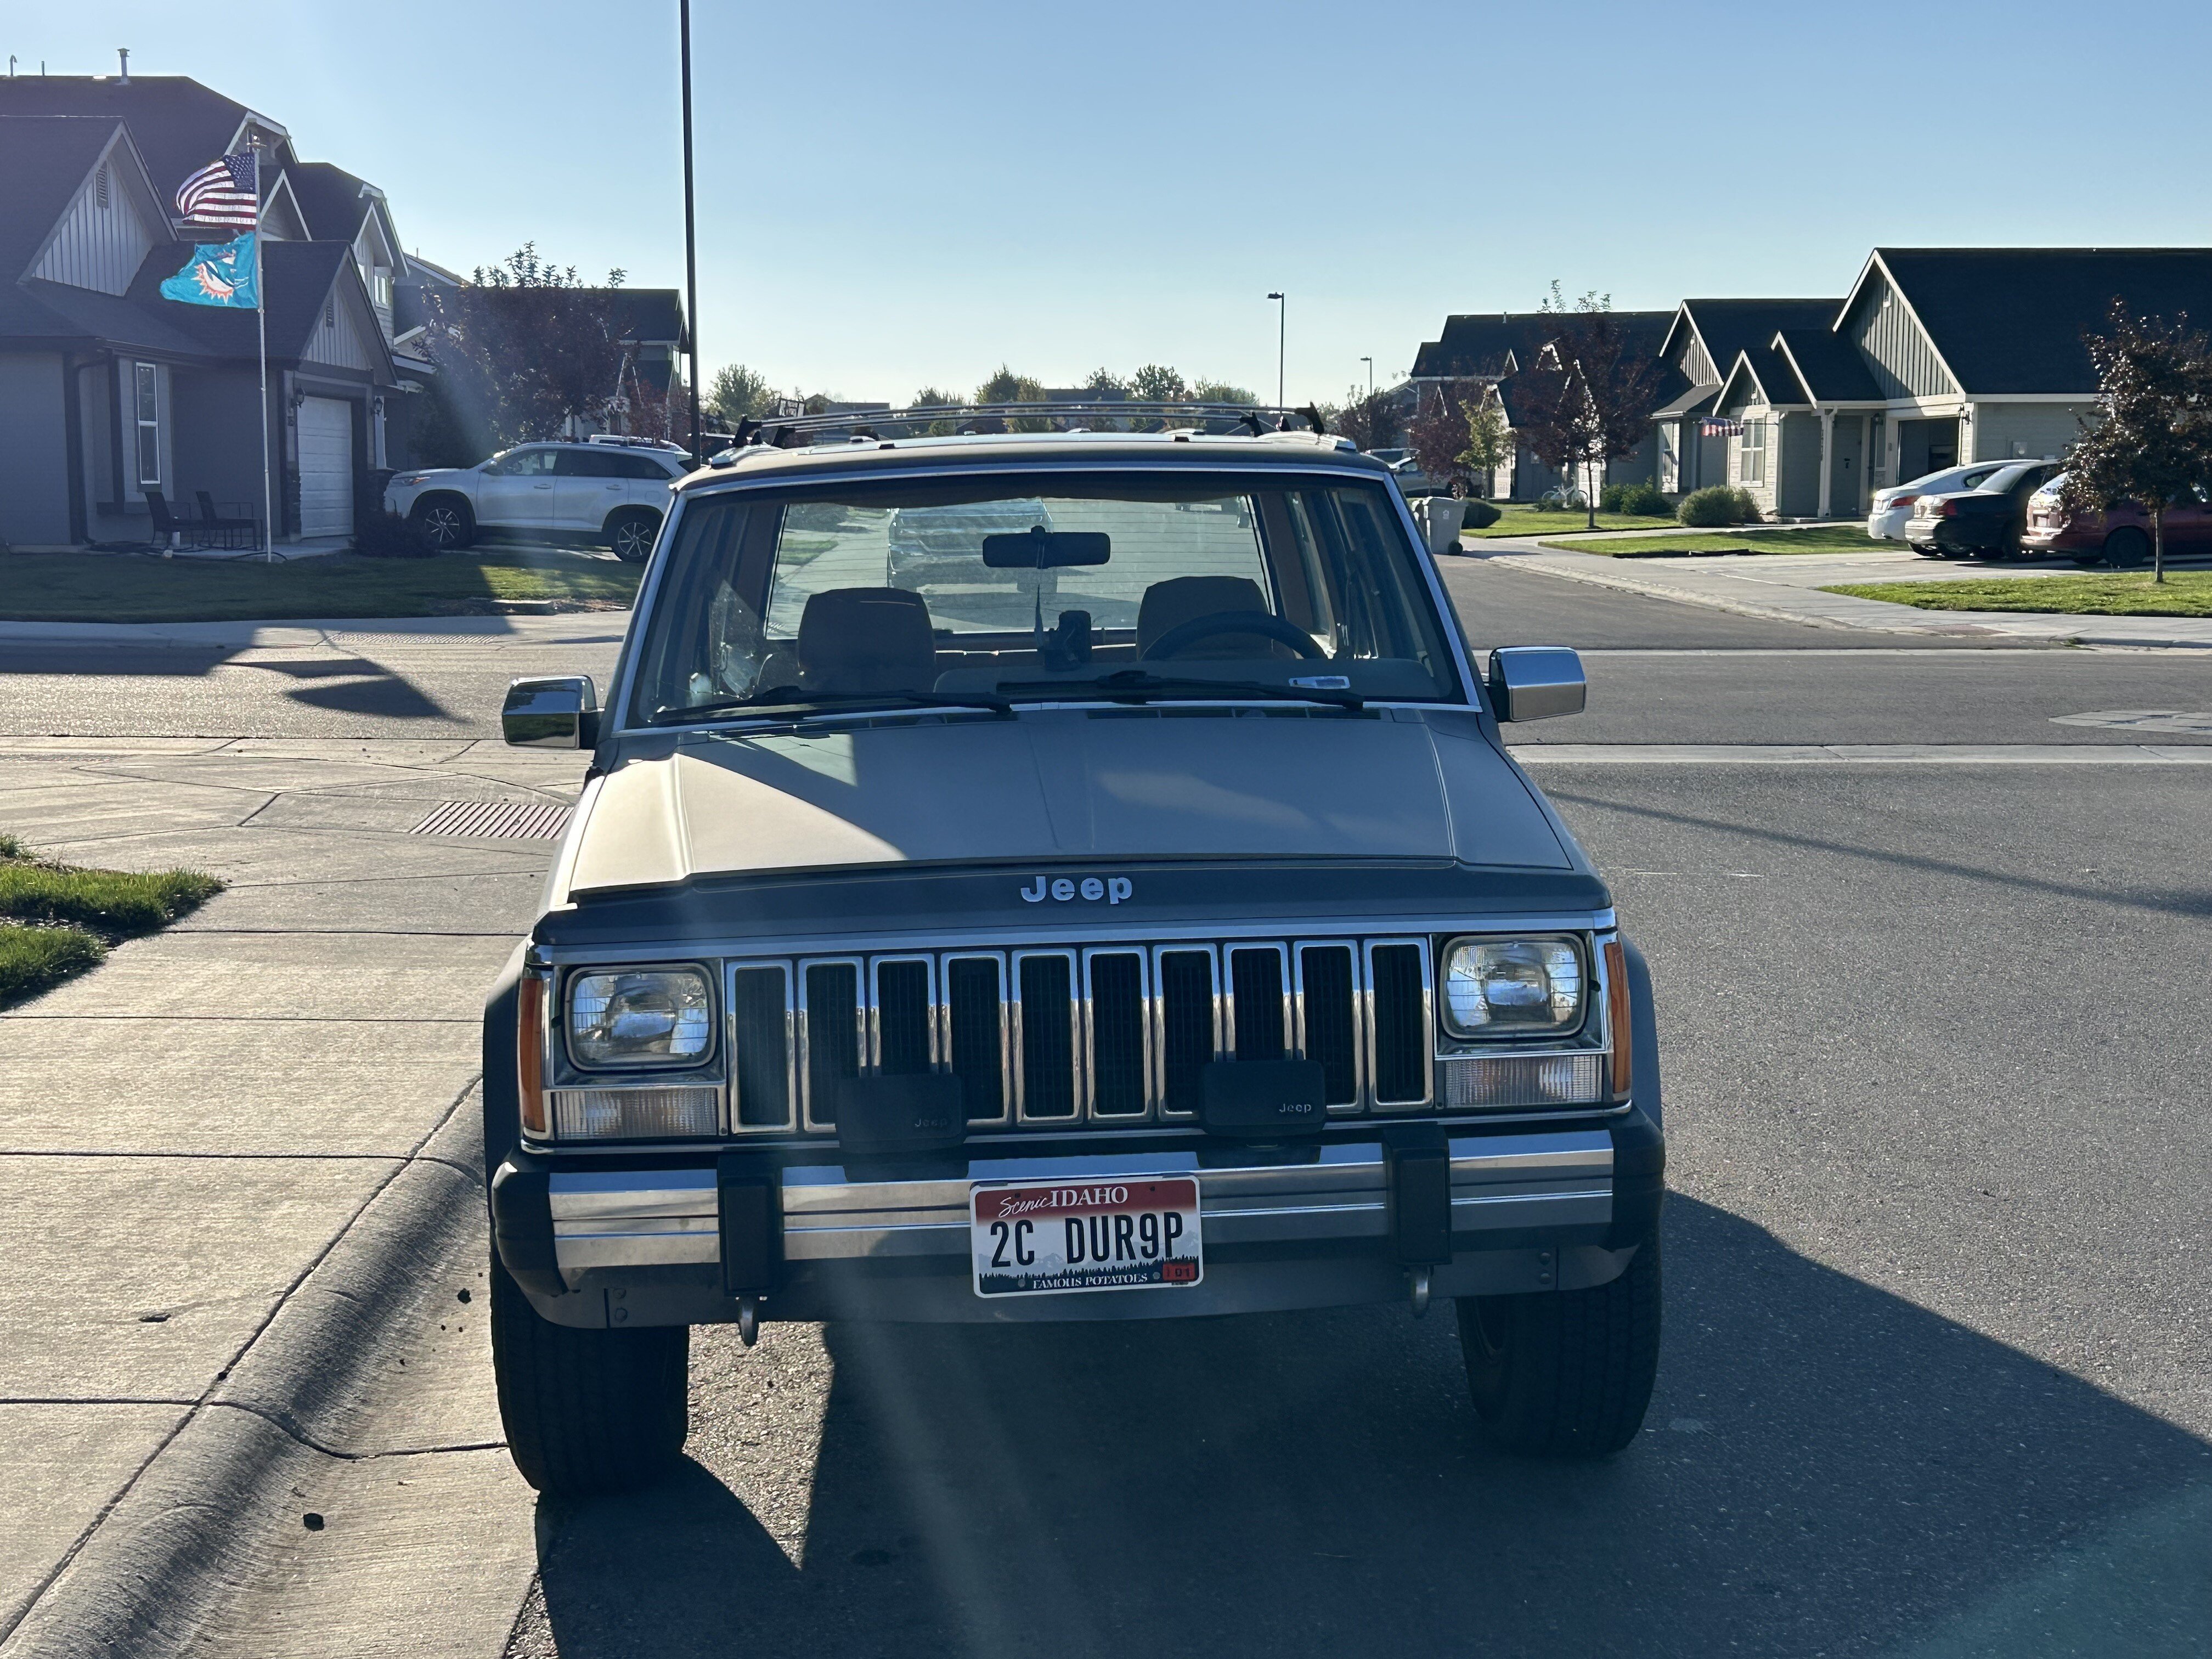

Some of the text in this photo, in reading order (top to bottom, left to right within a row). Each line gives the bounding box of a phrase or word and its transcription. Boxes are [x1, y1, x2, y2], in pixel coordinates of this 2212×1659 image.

[1020, 876, 1132, 904] Jeep
[1279, 1103, 1312, 1113] Jeep
[998, 1186, 1128, 1218] Scenic IDAHO
[990, 1211, 1183, 1268] 2C DUR9P
[1033, 1273, 1148, 1289] FAMOUS POTATOES
